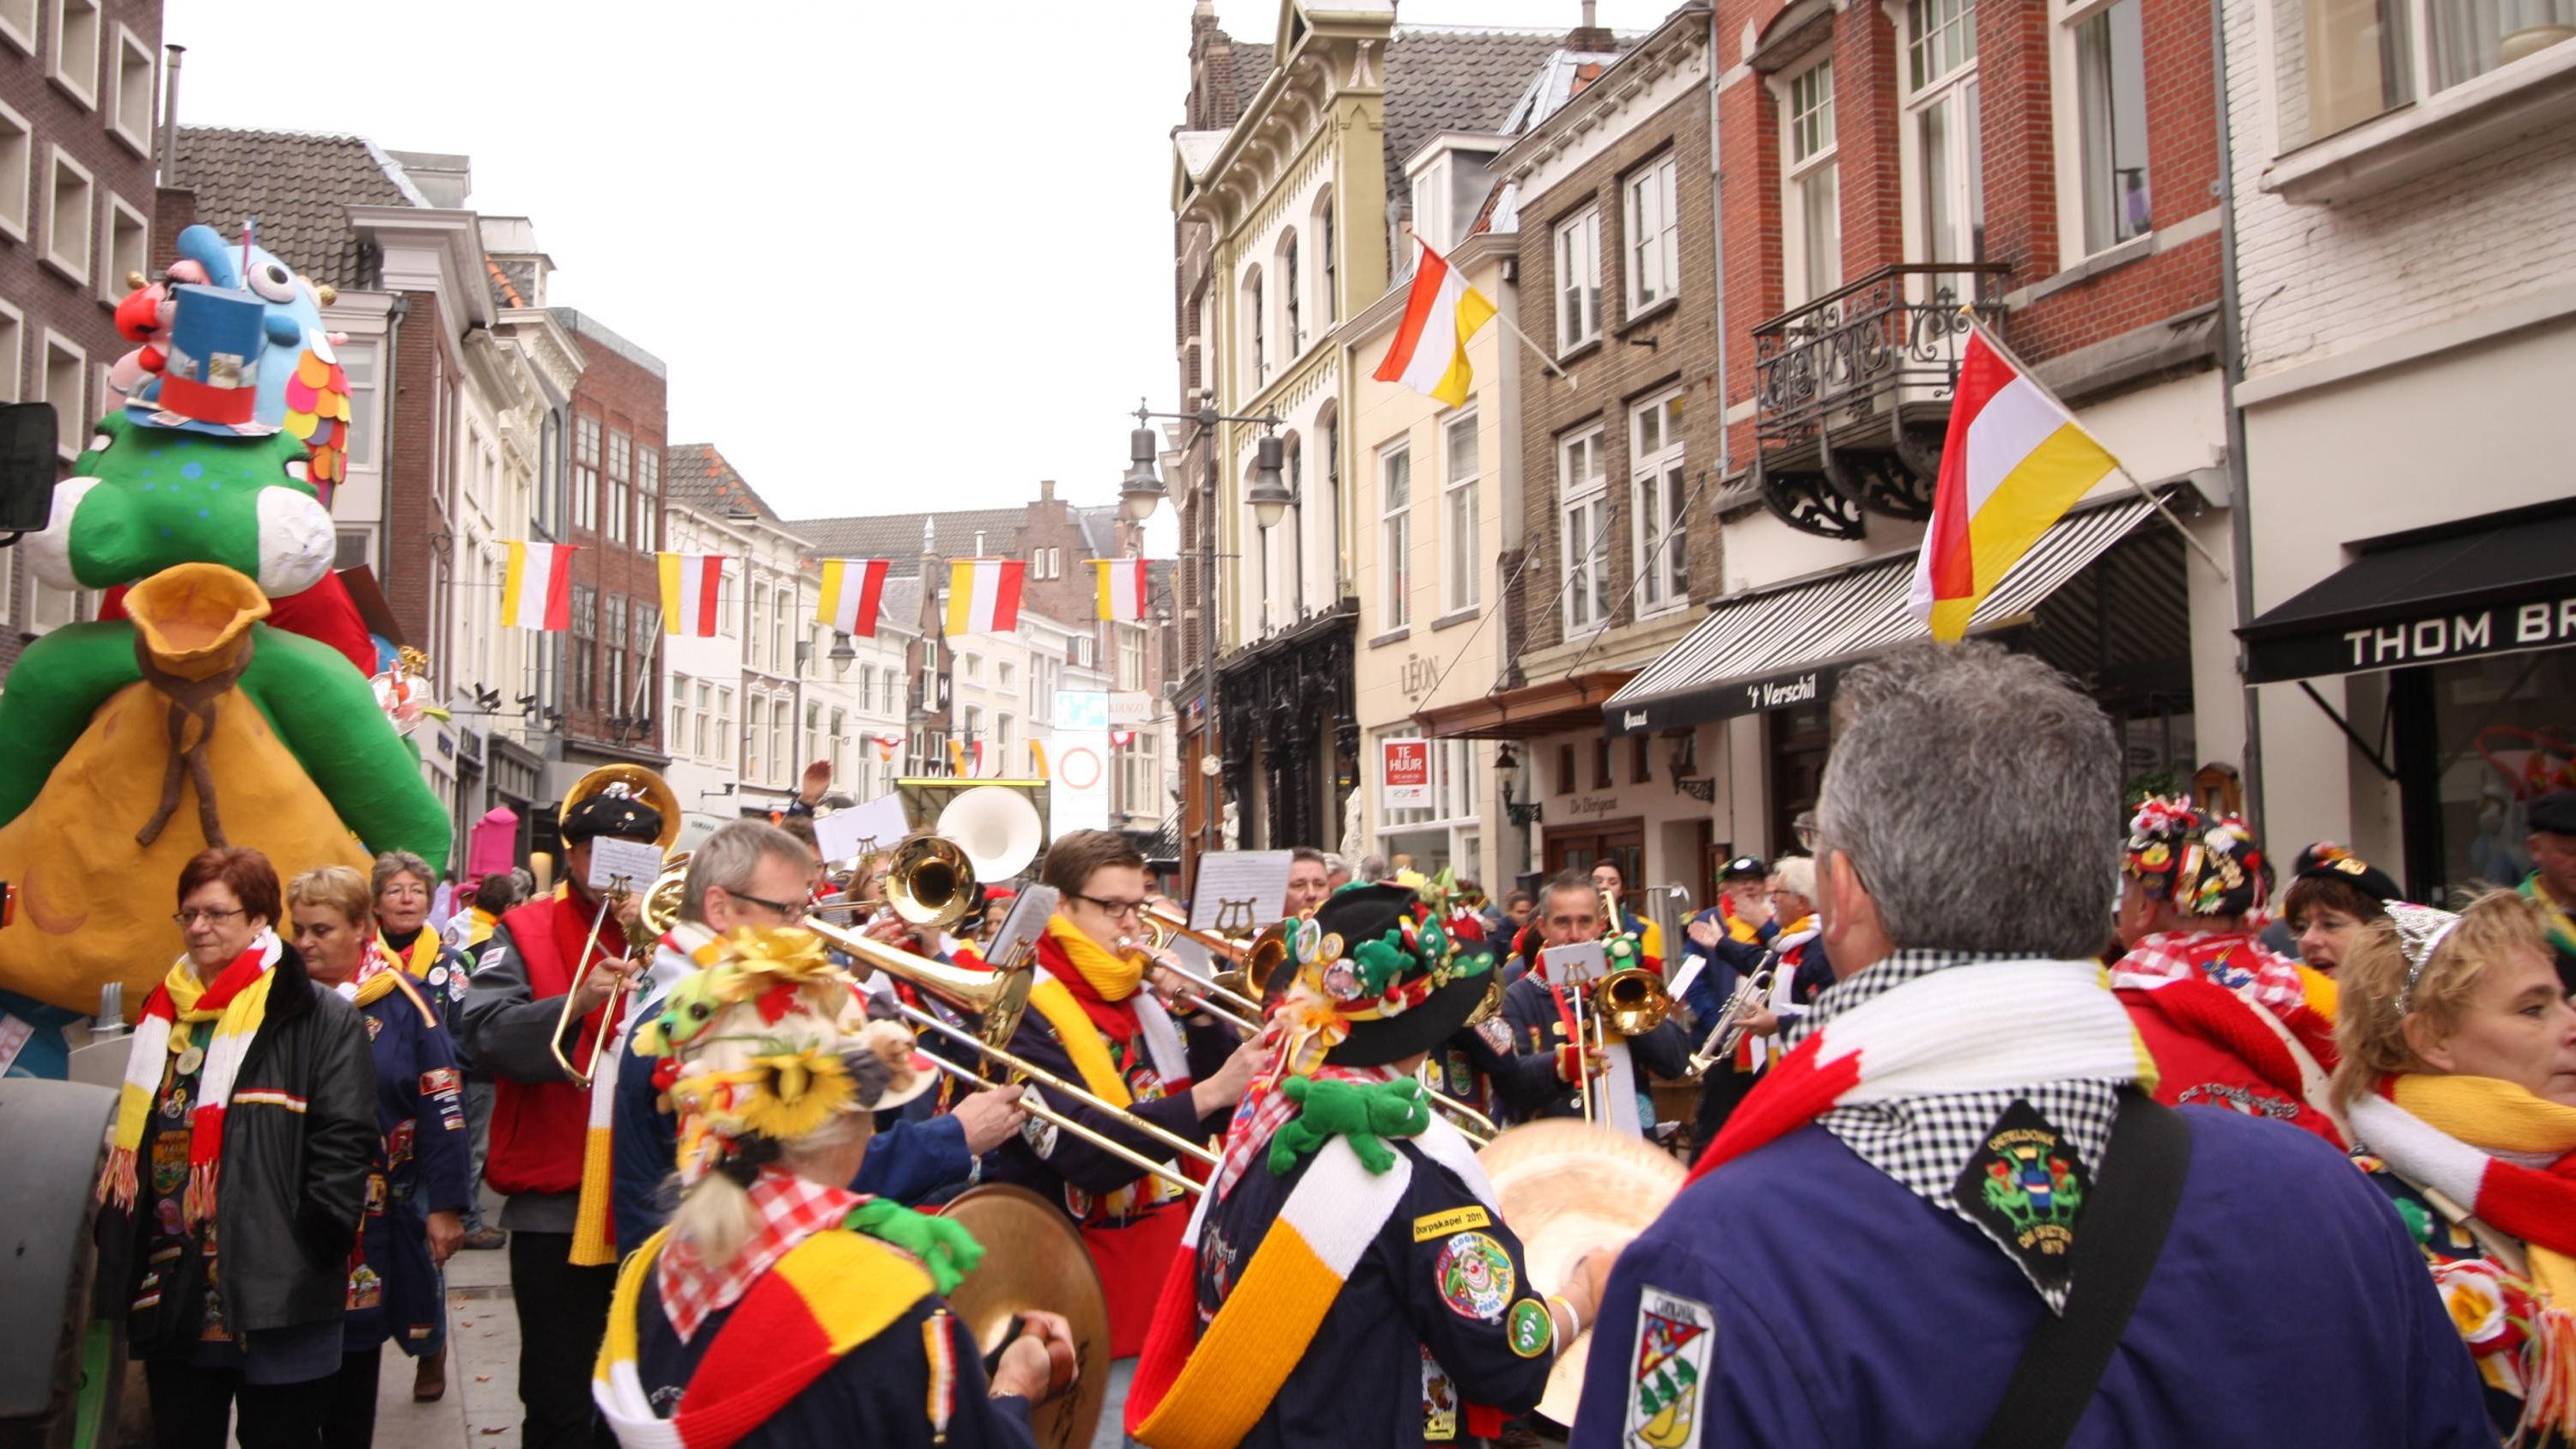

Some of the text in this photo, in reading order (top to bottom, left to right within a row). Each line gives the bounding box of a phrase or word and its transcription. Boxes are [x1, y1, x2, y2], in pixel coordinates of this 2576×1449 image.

[2343, 611, 2491, 667] THOM
[1746, 673, 1816, 709] 't Verschil
[1396, 746, 1411, 758] TE
[1389, 758, 1422, 771] HUUR
[1570, 796, 1617, 818] De Dirigent
[1416, 1212, 1483, 1235] Dorpskapel 2011
